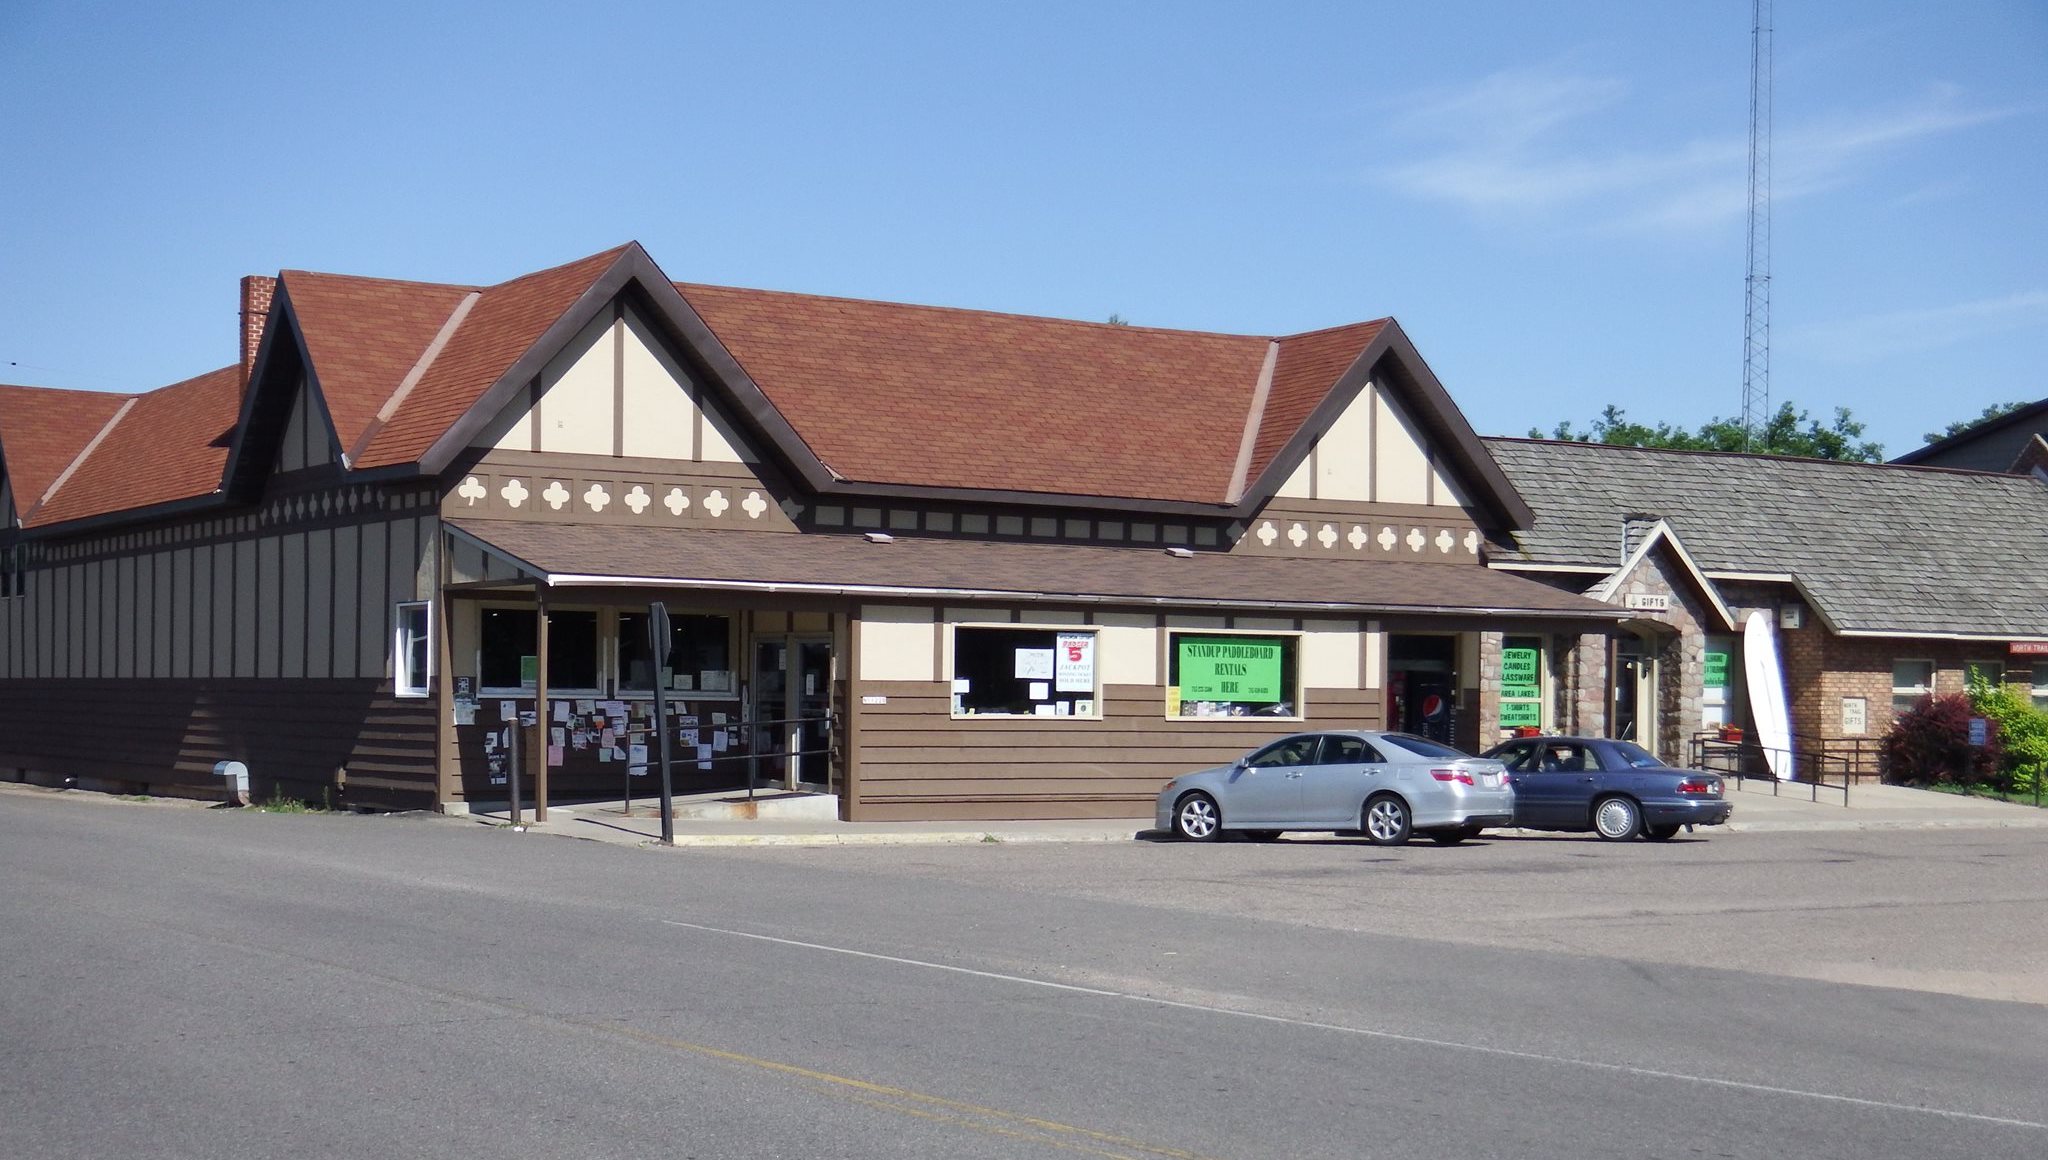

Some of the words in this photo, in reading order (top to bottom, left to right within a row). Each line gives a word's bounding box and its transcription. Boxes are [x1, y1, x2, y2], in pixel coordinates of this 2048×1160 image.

[1641, 597, 1665, 607] GIFTS
[1187, 645, 1221, 658] STANDUP
[1222, 646, 1274, 660] PADDLEBOARD
[2012, 644, 2032, 653] NORTH
[1068, 646, 1082, 662] 5
[1503, 651, 1531, 659] JEWELRY
[1214, 663, 1247, 676] RENTALS
[1503, 662, 1531, 670] CANDLES
[1501, 673, 1534, 681] LASSWARE
[1220, 681, 1240, 693] HERE
[1500, 713, 1537, 721] SWEATSHIRTS
[1845, 716, 1862, 725] GIFTS
